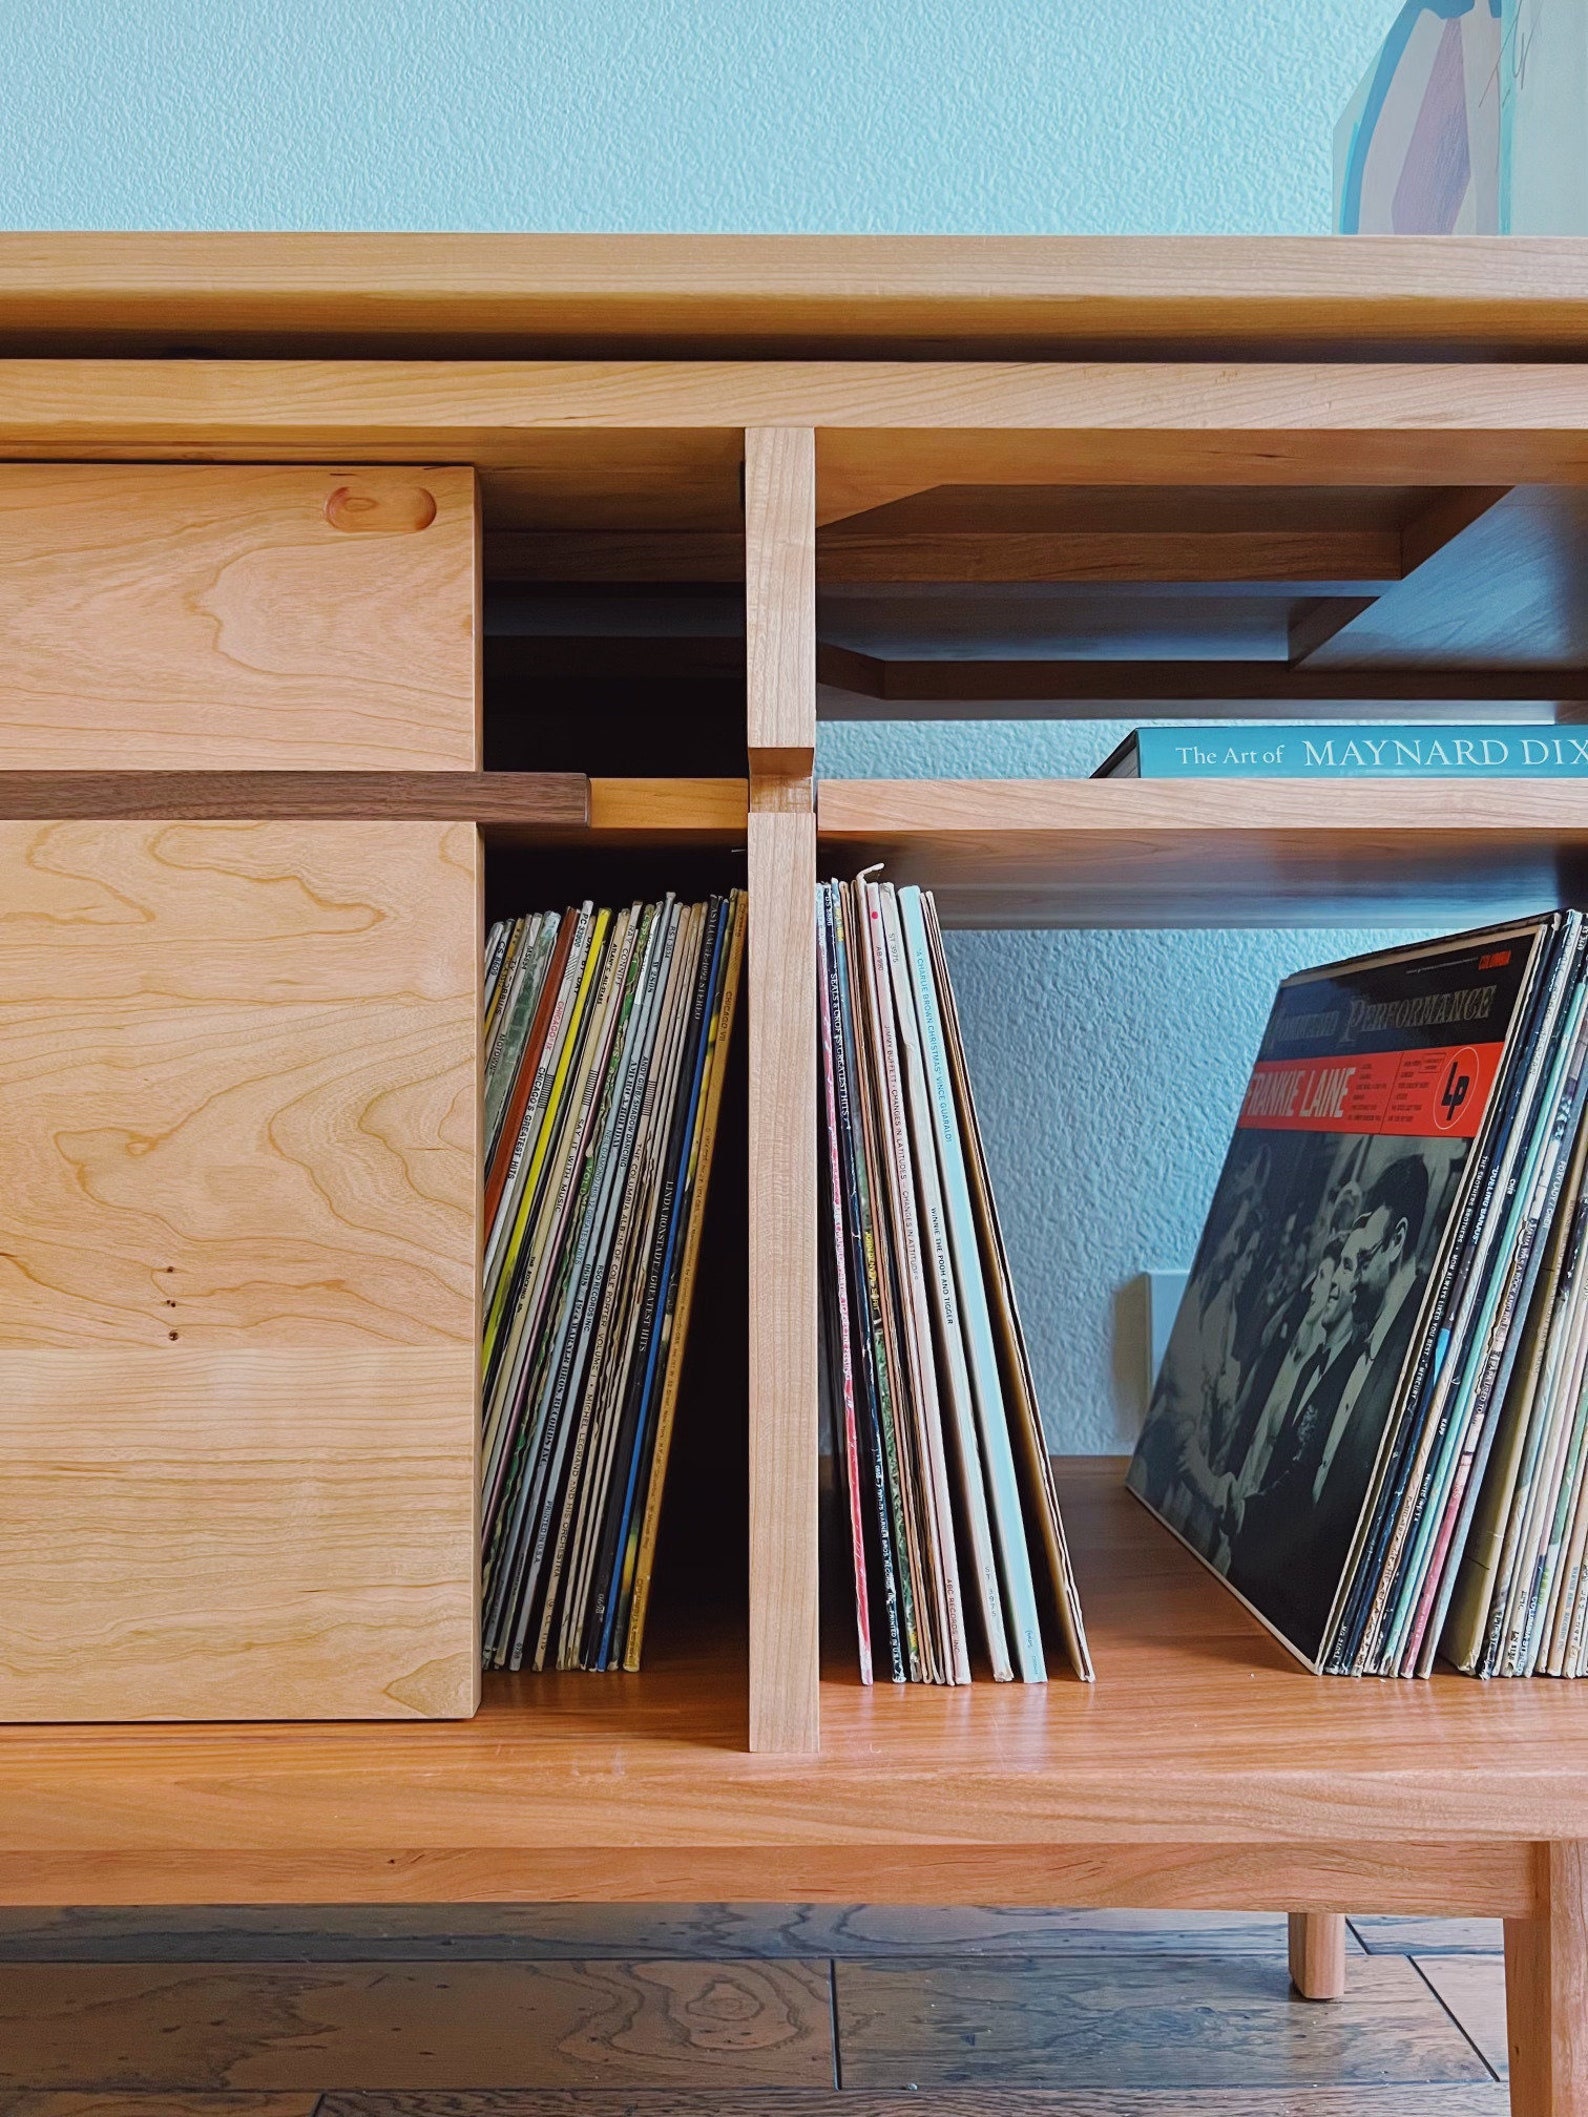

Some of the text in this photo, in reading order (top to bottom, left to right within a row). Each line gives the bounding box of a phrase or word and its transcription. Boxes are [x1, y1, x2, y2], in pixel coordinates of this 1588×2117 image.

[1175, 746, 1216, 765] The
[1222, 746, 1256, 765] Art
[1262, 744, 1285, 765] of
[1304, 738, 1509, 767] MAYNARD
[705, 907, 717, 945] ASYLUM
[613, 924, 635, 986] RAY CONNIFF
[890, 944, 898, 963] 3975
[830, 973, 838, 1001] SEALS
[917, 958, 927, 991] CHARLIE
[693, 982, 705, 1020] STEREO
[721, 990, 732, 1028] CHICAGO
[922, 993, 932, 1024] BROWN
[1340, 985, 1497, 1044] PERFORMANCE
[547, 999, 564, 1038] CHICAGO
[883, 1025, 892, 1048] JIMMY
[639, 1055, 648, 1076] ANDY
[836, 1047, 846, 1092] GREATEST
[886, 1050, 896, 1082] BUFFETT
[935, 1075, 944, 1100] VINCE
[1243, 1069, 1306, 1117] FRANKIE
[1299, 1066, 1357, 1118] LAINE
[1441, 1061, 1470, 1121] LP
[626, 1099, 639, 1132] SHADOW
[840, 1094, 848, 1115] HITS
[891, 1089, 900, 1126] CHANGES
[506, 1066, 545, 1181] CHICAGO'S GREATEST HITS
[574, 1117, 584, 1135] SAY
[939, 1102, 951, 1143] GUARALDI
[563, 1154, 575, 1178] WITH
[619, 1133, 632, 1168] DANCING
[632, 1142, 642, 1160] THE
[896, 1138, 907, 1180] LATITUDES
[1482, 1164, 1499, 1207] "DUELING
[1555, 1160, 1567, 1180] FOXY
[554, 1183, 567, 1213] MUSIC
[623, 1162, 638, 1211] COLUMBIA
[661, 1180, 673, 1211] LINDA
[1468, 1171, 1482, 1206] SMOTHERS
[1548, 1180, 1561, 1201] LADY
[902, 1190, 912, 1226] CHANGES
[930, 1207, 940, 1235] WINNIE
[1541, 1207, 1553, 1229] CHER
[579, 1209, 593, 1246] GREATEST
[652, 1214, 668, 1266] RONSTADT
[1457, 1208, 1471, 1243] BROTHERS
[575, 1247, 584, 1265] HITS
[937, 1255, 946, 1276] POOH
[1516, 1245, 1528, 1265] WAS
[594, 1264, 604, 1281] RSO
[608, 1263, 618, 1288] COLE
[941, 1278, 949, 1294] AND
[1440, 1271, 1452, 1299] ALWAYS
[1508, 1271, 1521, 1293] ROCK
[587, 1281, 600, 1317] RECORDS
[600, 1290, 613, 1327] PORTER
[643, 1274, 658, 1326] GREATEST
[944, 1297, 953, 1324] TIGGER
[1433, 1299, 1443, 1320] LIKED
[1503, 1293, 1514, 1310] AND
[638, 1328, 649, 1352] HITS
[1428, 1321, 1437, 1336] YOU
[592, 1332, 605, 1370] VOLUME
[1423, 1338, 1432, 1356] BEST
[1410, 1366, 1424, 1399] MERCURY
[1485, 1360, 1496, 1380] PAPA
[1479, 1381, 1490, 1402] USED
[544, 1396, 561, 1445] RECORDS
[581, 1393, 593, 1427] MICHEL
[1437, 1418, 1447, 1435] KAPP
[571, 1431, 586, 1477] LEGRAND
[540, 1500, 552, 1533] PRINTED
[564, 1502, 573, 1519] HIS
[552, 1522, 569, 1578] ORCHESTRA
[879, 1511, 887, 1538] WARNER
[888, 1609, 896, 1637] PRINTED
